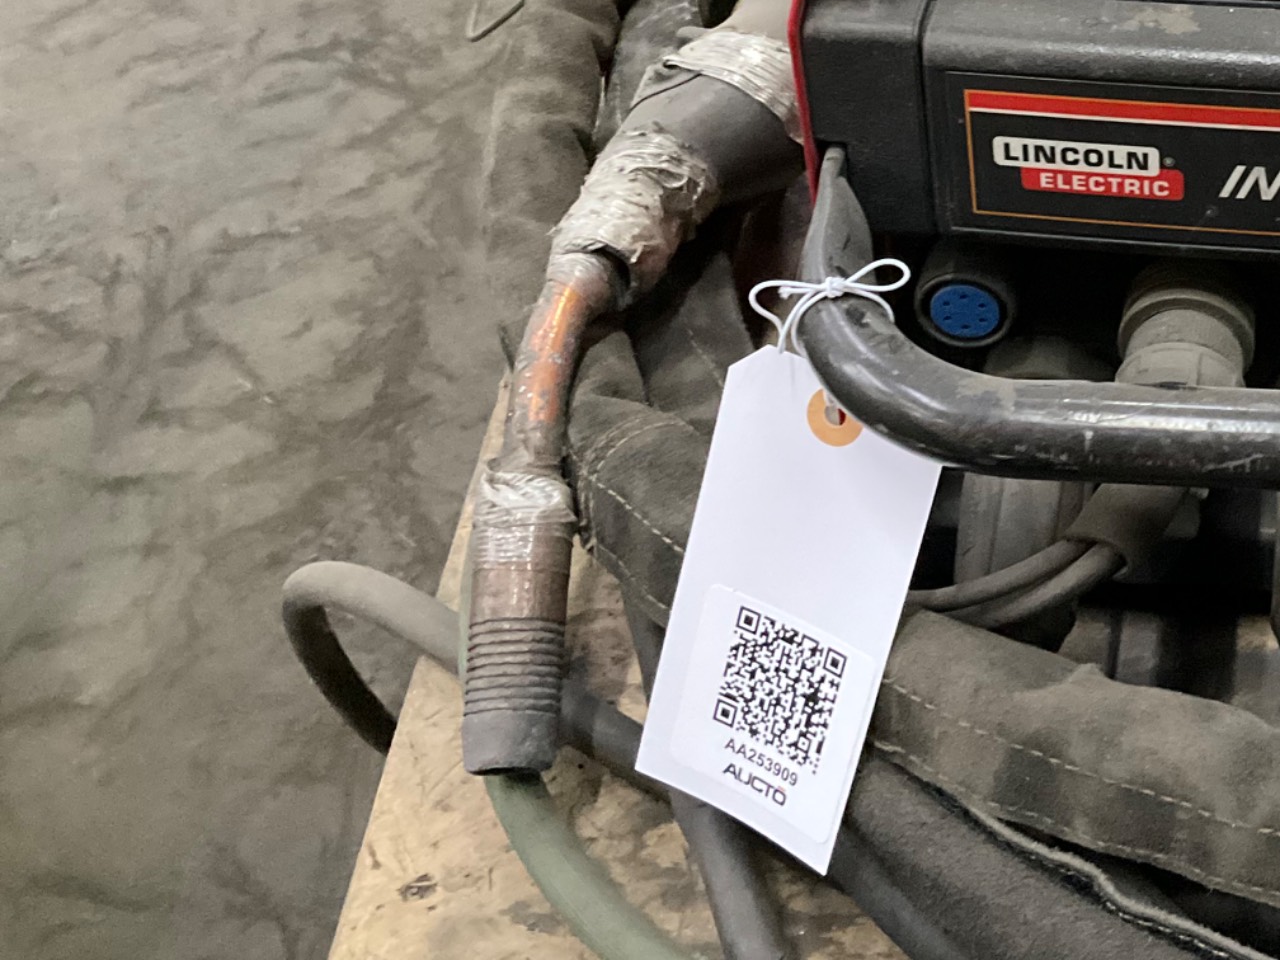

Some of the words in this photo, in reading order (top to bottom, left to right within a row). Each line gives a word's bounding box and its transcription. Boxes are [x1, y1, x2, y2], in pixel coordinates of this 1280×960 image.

[1003, 141, 1149, 171] LINCOLN
[1039, 172, 1170, 197] ELECTRIC
[724, 737, 799, 787] AA253909
